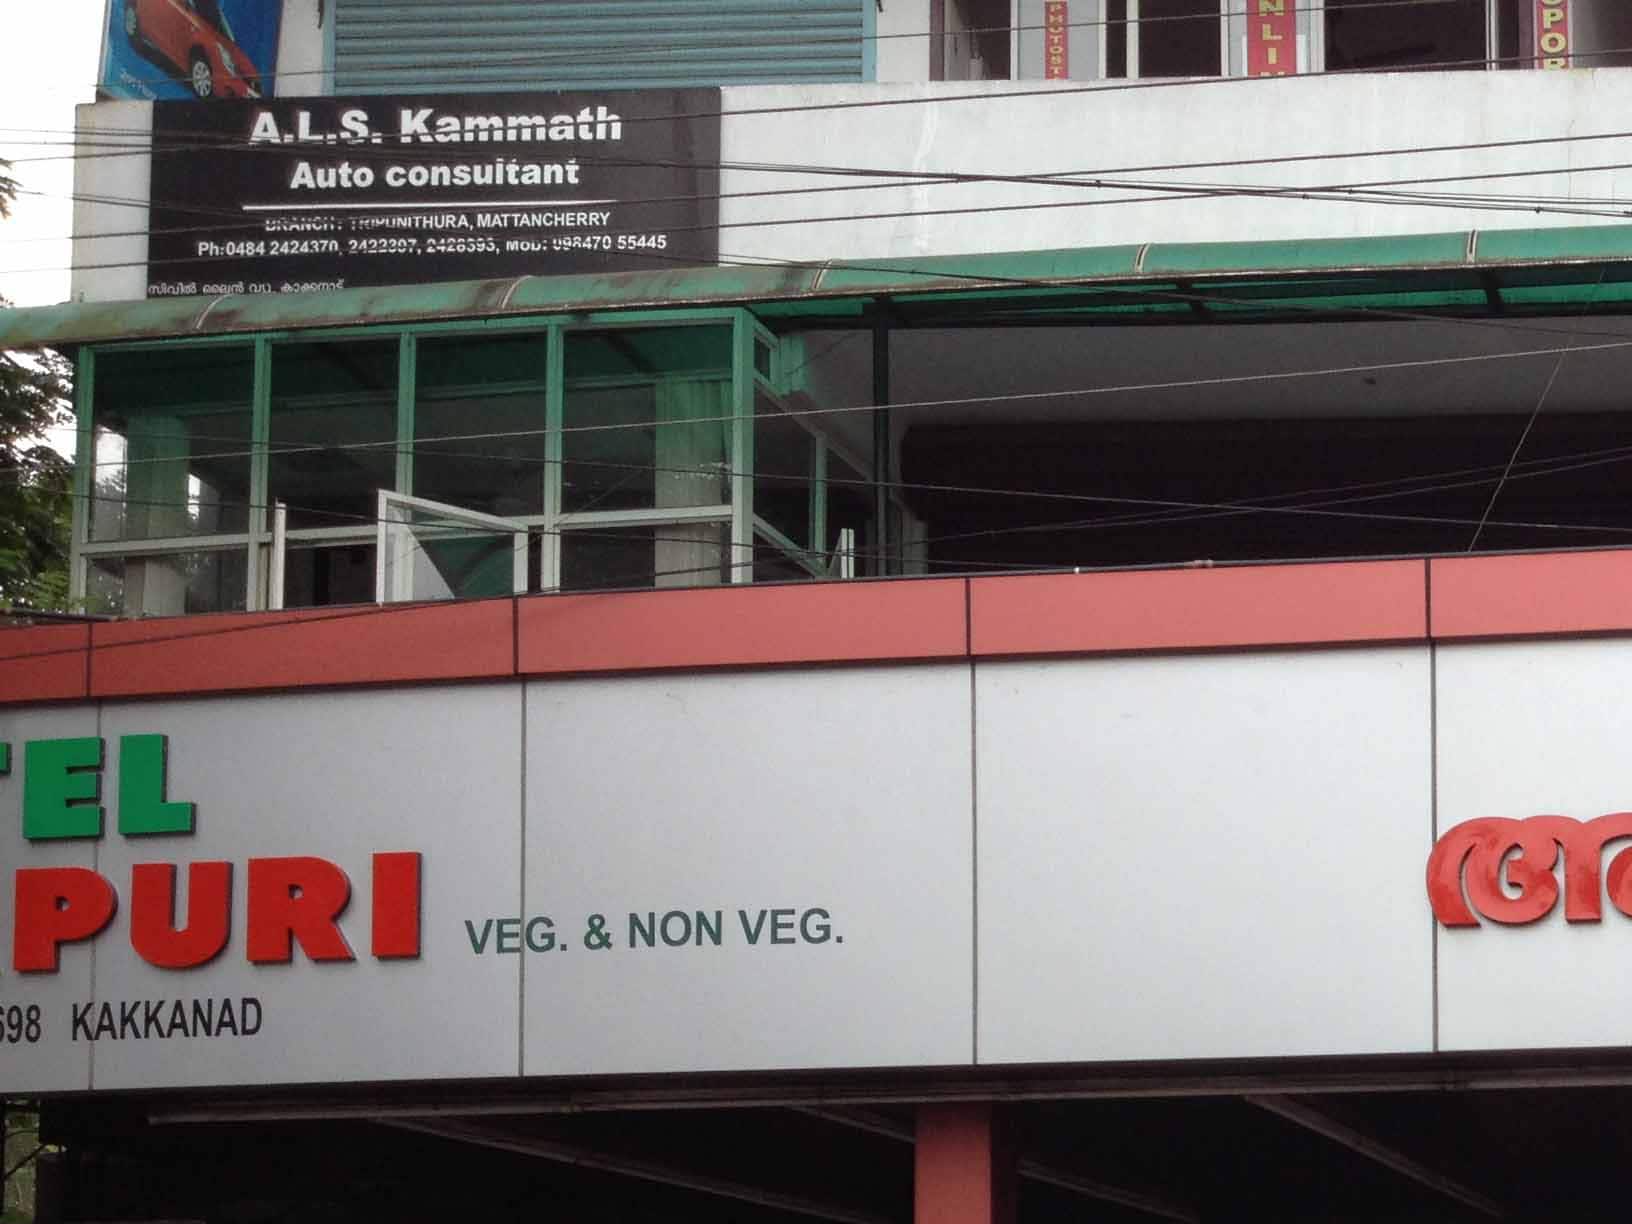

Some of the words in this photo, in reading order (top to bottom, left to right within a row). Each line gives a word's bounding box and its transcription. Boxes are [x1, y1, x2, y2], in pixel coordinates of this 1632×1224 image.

[249, 110, 382, 144] A.L.S.
[401, 106, 622, 143] Kammath
[290, 161, 375, 189] Auto
[477, 211, 610, 228] MATTANCHERRY
[617, 233, 667, 249] 55445
[464, 915, 568, 955] VEG.
[583, 913, 613, 951] &
[628, 909, 722, 949] NON
[737, 907, 844, 946] VEG.
[71, 996, 263, 1042] KAKKANAD
